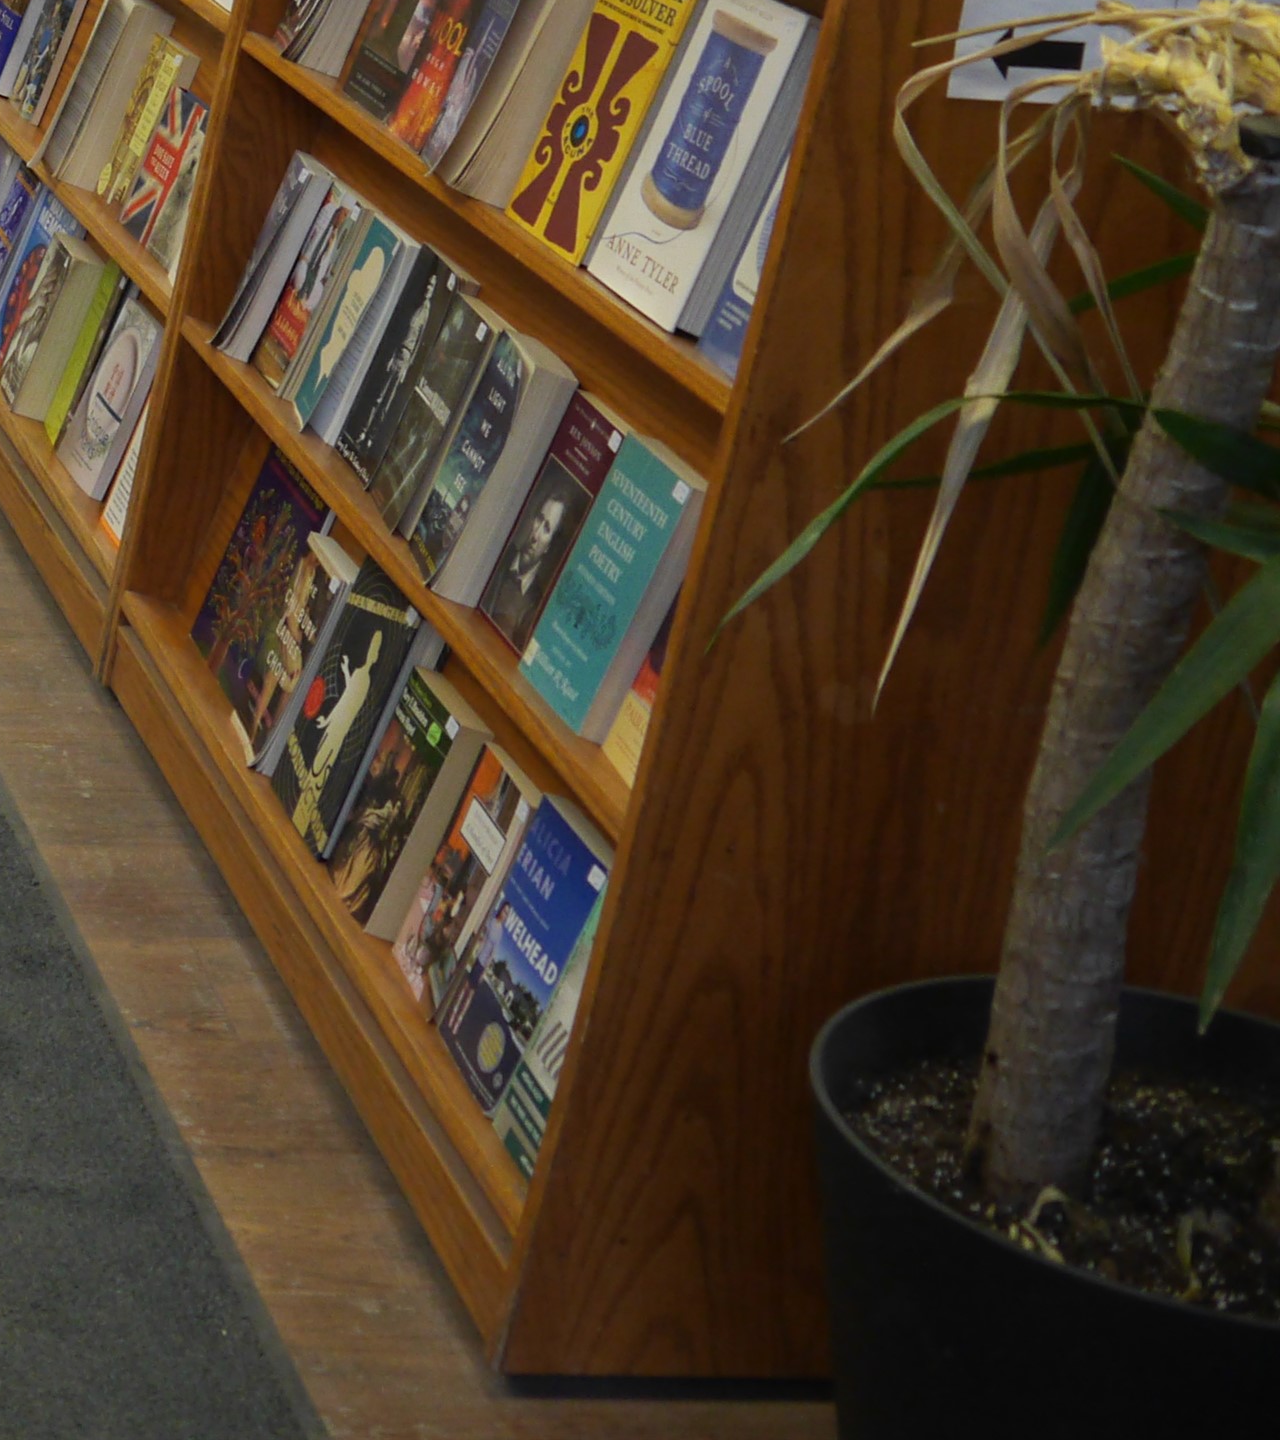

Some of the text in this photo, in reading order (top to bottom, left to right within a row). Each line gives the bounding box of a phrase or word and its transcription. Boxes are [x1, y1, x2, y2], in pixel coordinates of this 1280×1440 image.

[697, 74, 735, 112] SPOOL
[684, 122, 713, 152] BLUE
[667, 141, 711, 181] THREAD
[606, 233, 681, 296] ANNE TYLER
[607, 498, 647, 543] CENTURY
[611, 468, 669, 530] SEVENTEENTH
[597, 520, 636, 564] ENGLISH
[588, 544, 624, 585] POETRY
[529, 817, 573, 877] ALICIA
[495, 890, 558, 986] TWELHEAD
